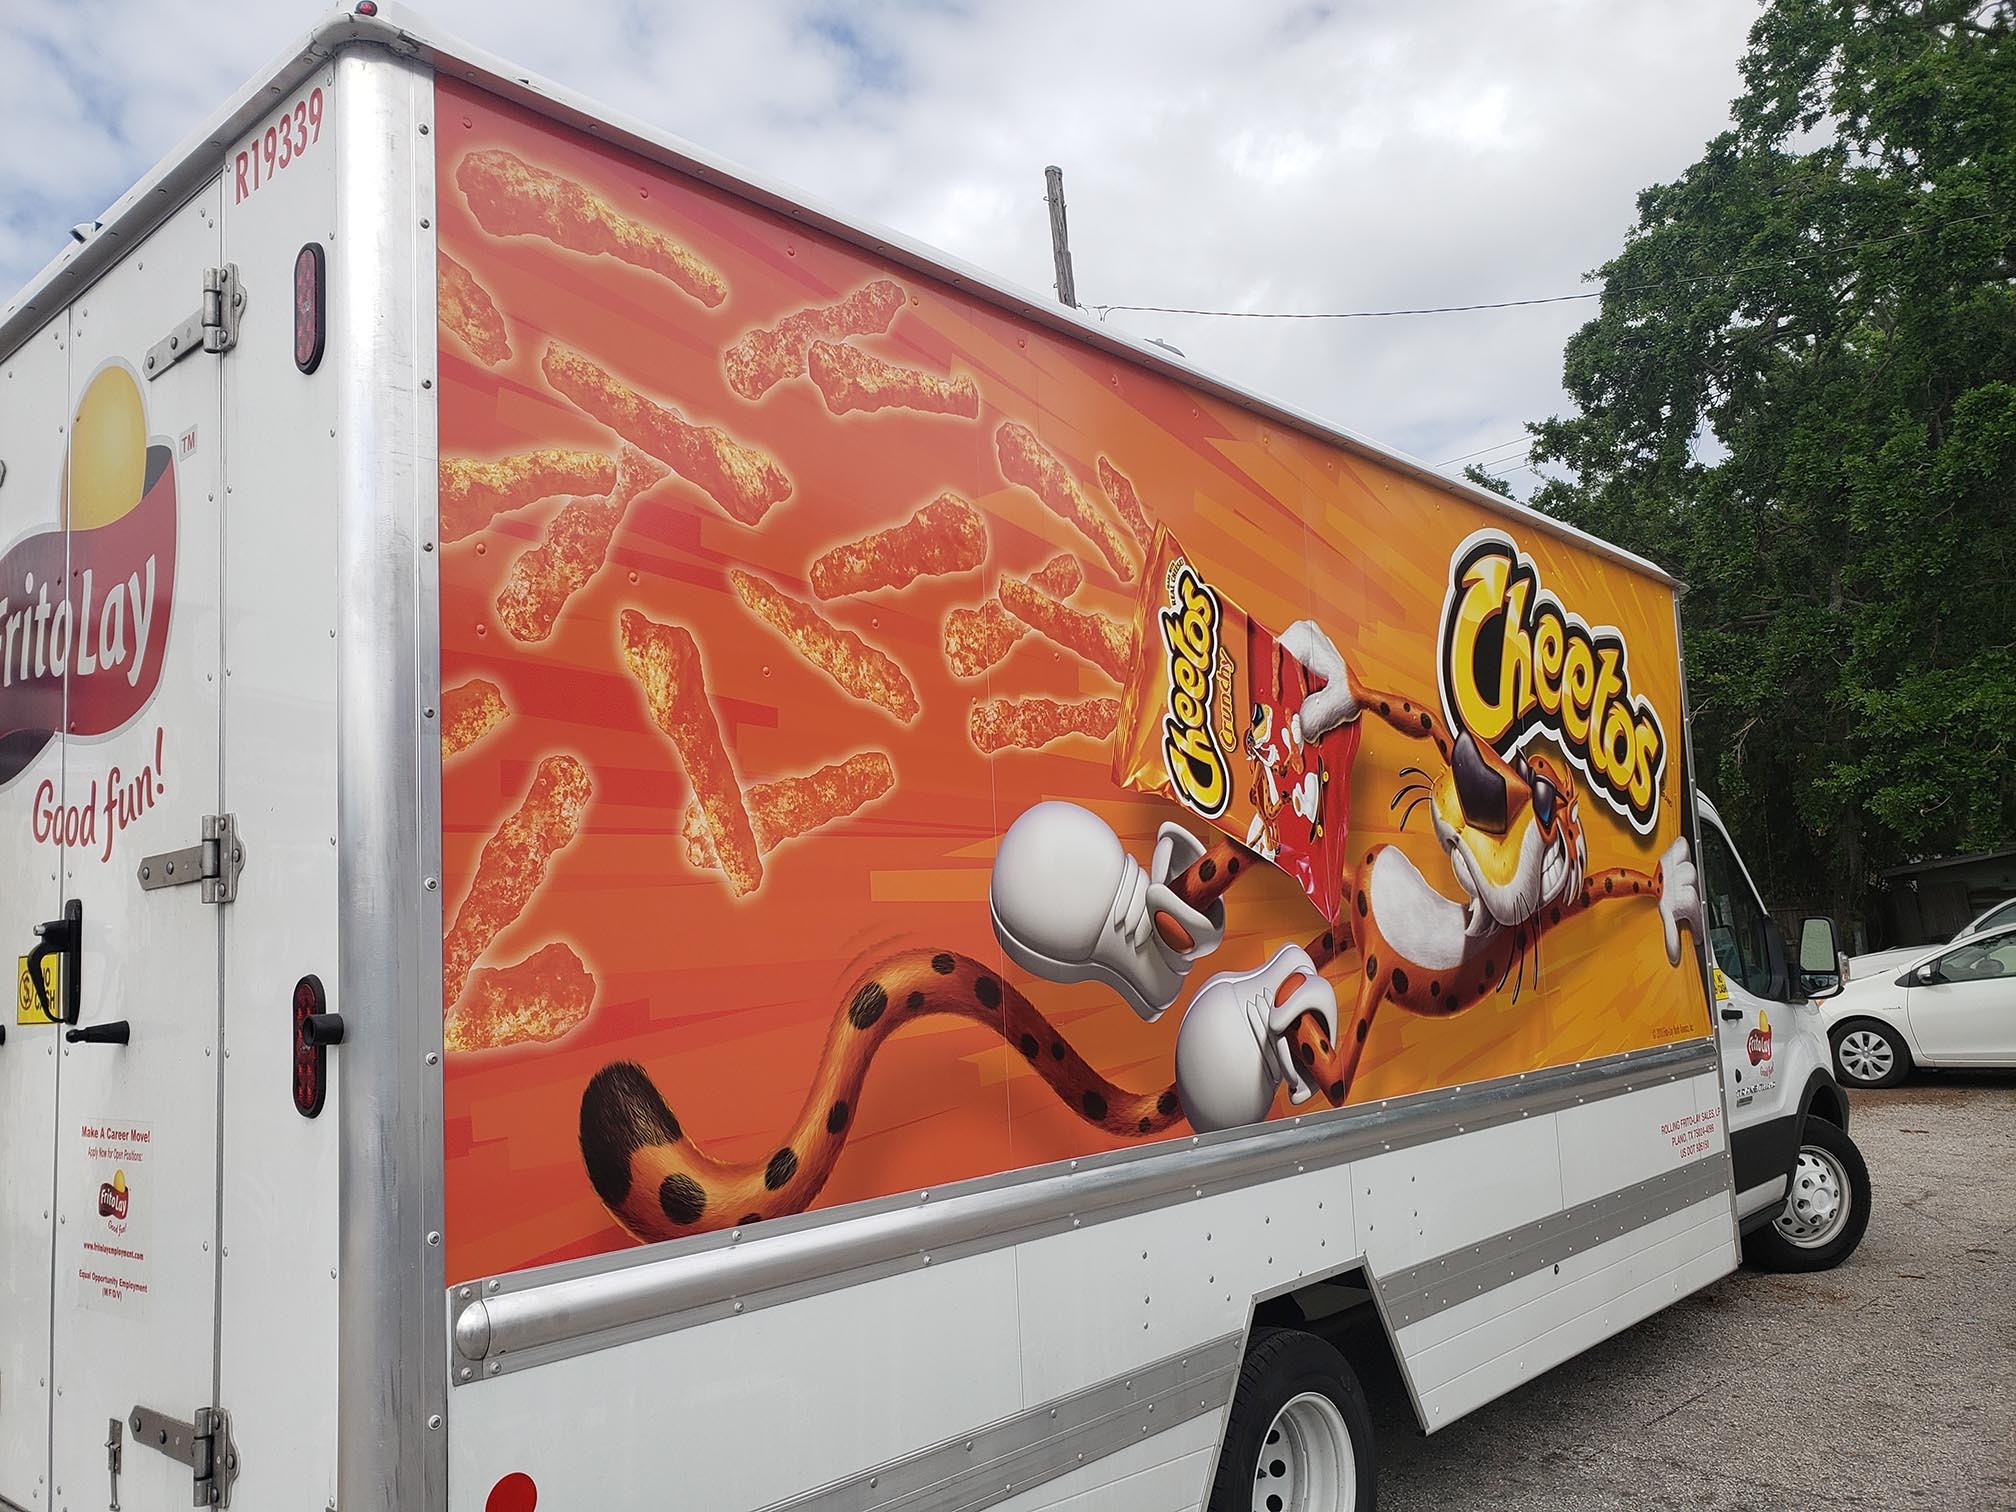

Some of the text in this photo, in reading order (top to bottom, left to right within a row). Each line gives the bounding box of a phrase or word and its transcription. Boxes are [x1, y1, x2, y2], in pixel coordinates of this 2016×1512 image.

[235, 88, 323, 205] R19339
[181, 431, 196, 455] TM
[1164, 572, 1226, 812] Cheetos
[1217, 648, 1236, 753] Crunchy
[1450, 550, 1660, 810] Cheetos
[33, 727, 164, 863] Good fun!
[81, 1126, 151, 1143] Make A Career Move!
[1661, 1120, 1681, 1135] ROLLING
[1680, 1113, 1701, 1129] FRITO-LAY
[1680, 1147, 1687, 1158] US
[1687, 1143, 1696, 1156] DOT
[79, 1269, 148, 1293] Equal Opportunity Employment
